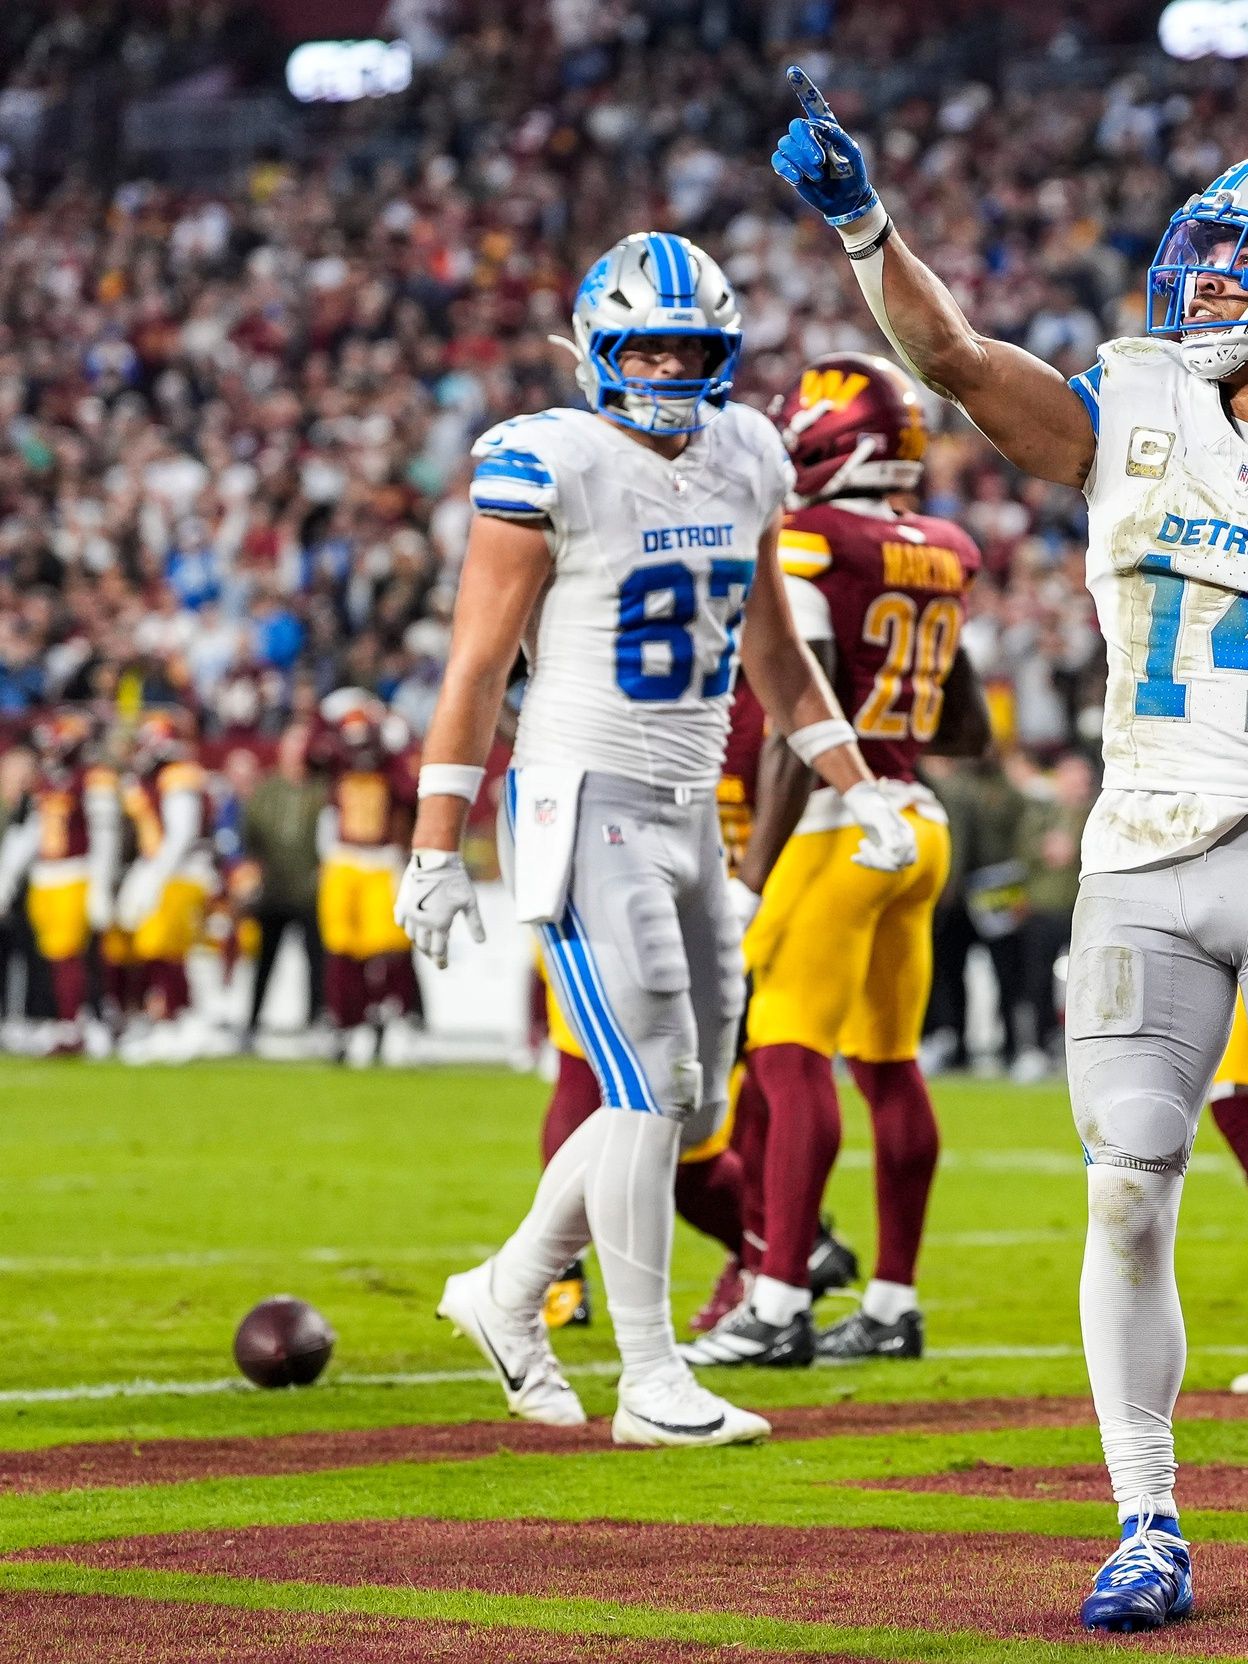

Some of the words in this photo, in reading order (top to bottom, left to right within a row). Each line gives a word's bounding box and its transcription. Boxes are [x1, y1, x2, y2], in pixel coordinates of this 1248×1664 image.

[1132, 429, 1171, 465] C
[642, 525, 733, 552] DETROIT
[615, 558, 757, 702] 87
